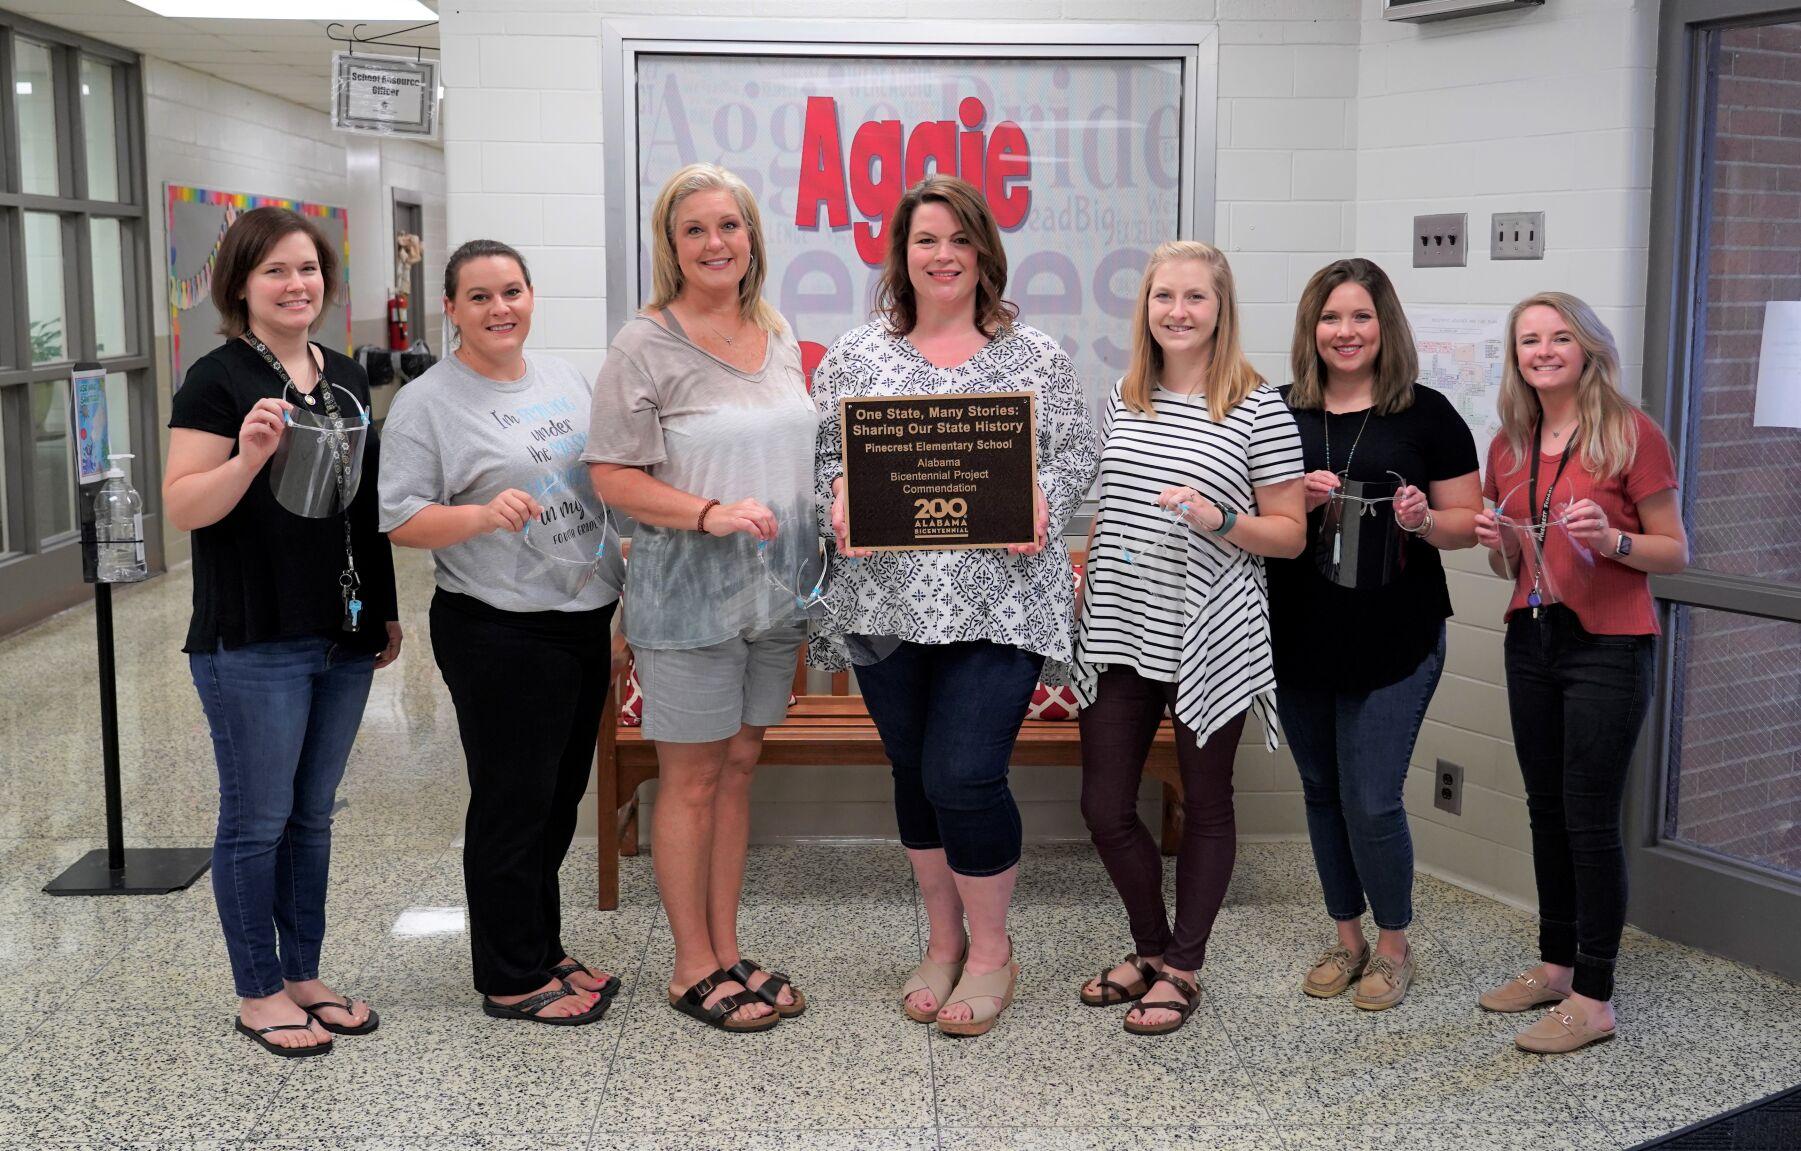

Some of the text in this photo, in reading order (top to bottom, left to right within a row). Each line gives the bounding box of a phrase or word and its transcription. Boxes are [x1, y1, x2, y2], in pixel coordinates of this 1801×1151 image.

[352, 72, 380, 83] School
[372, 86, 400, 97] Officer
[795, 95, 1031, 266] Aggie
[1024, 195, 1116, 246] eadBig
[856, 405, 1019, 420] One State, Many Stories:
[531, 418, 574, 441] under
[853, 421, 1024, 437] Sharing Our State History
[865, 440, 1012, 453] Pinecrest Elementary School
[526, 445, 552, 464] the
[917, 458, 961, 468] Alabama
[890, 470, 989, 481] Bicentennial Project
[903, 484, 977, 494] Commendation
[540, 506, 557, 526] in
[560, 499, 585, 520] my
[914, 497, 968, 519] 200
[915, 519, 968, 527] ALABAMA
